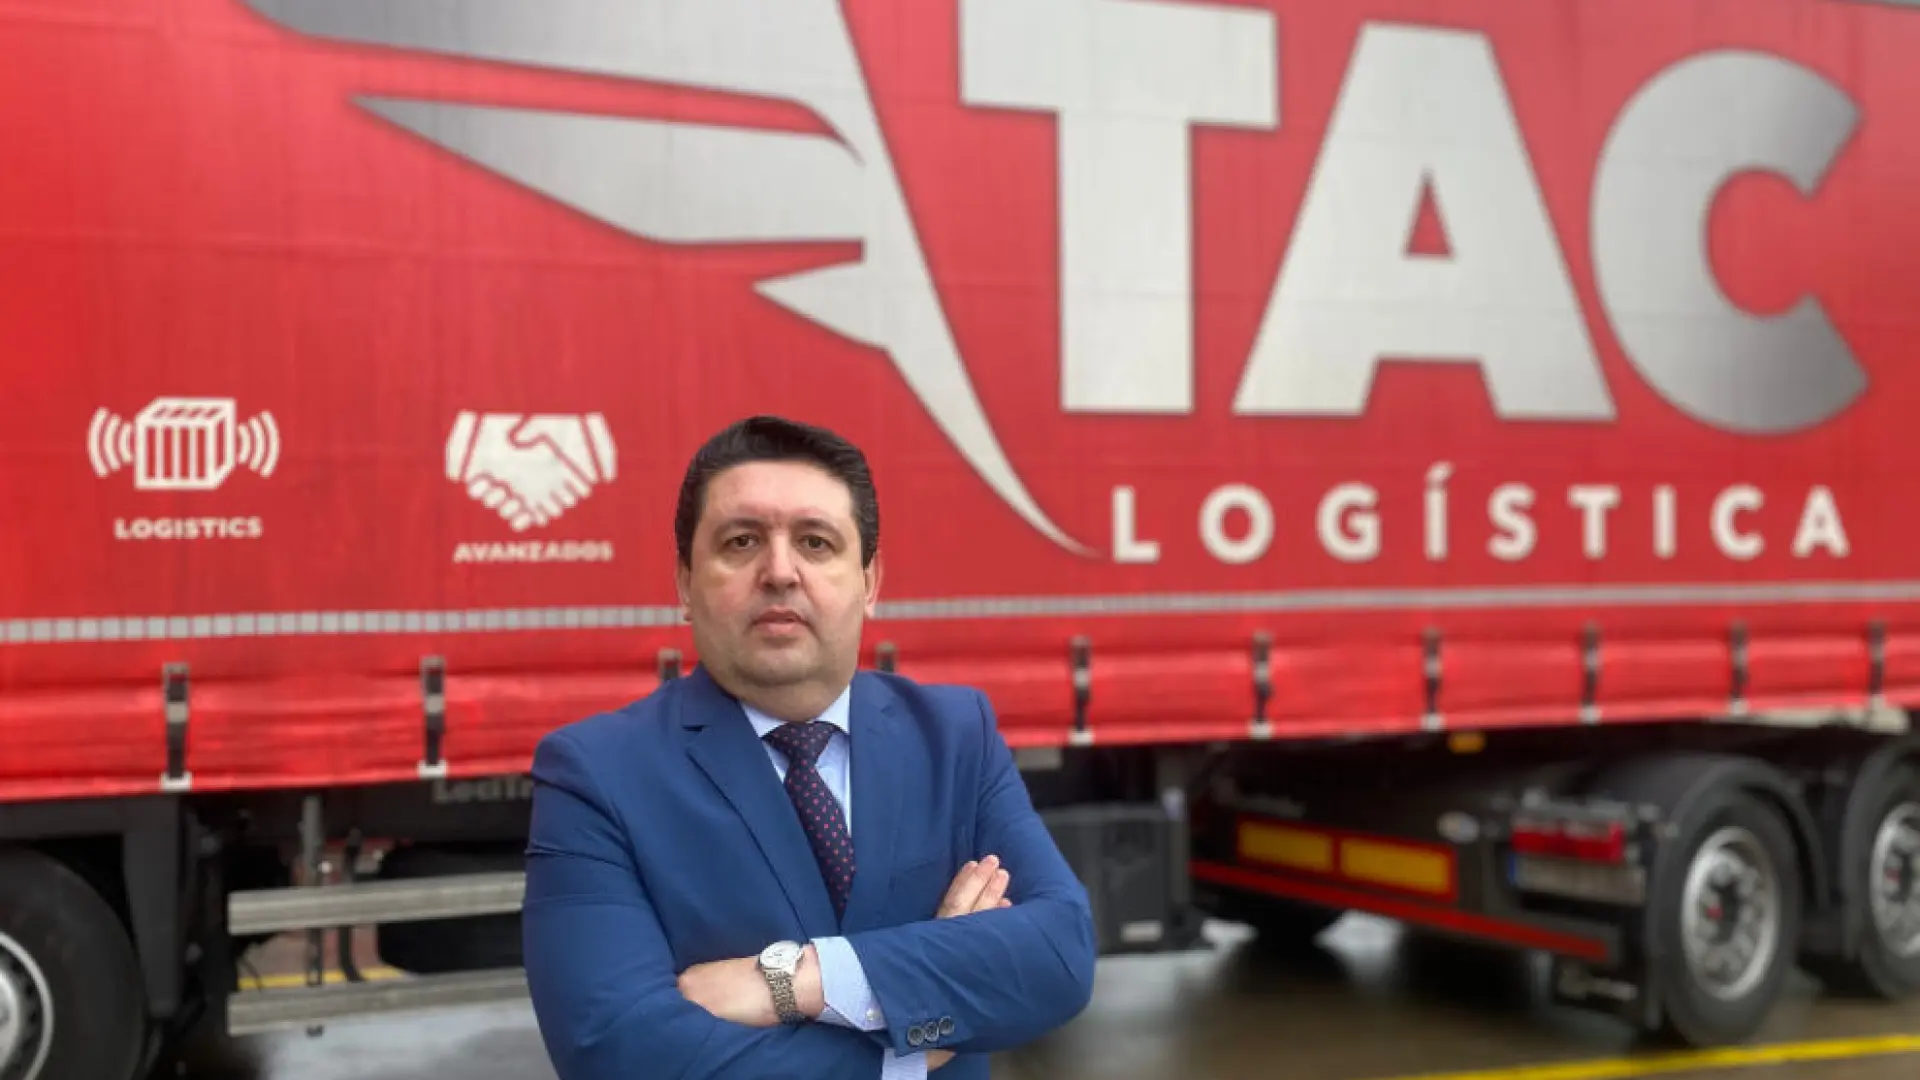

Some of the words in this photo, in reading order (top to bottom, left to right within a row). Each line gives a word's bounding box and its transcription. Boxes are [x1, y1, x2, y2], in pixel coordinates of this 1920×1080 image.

[959, 0, 1867, 434] TAC
[114, 515, 263, 540] LOGISTICS
[1111, 463, 1849, 563] LOGÍSTICA
[453, 540, 613, 563] AVANZADOS
